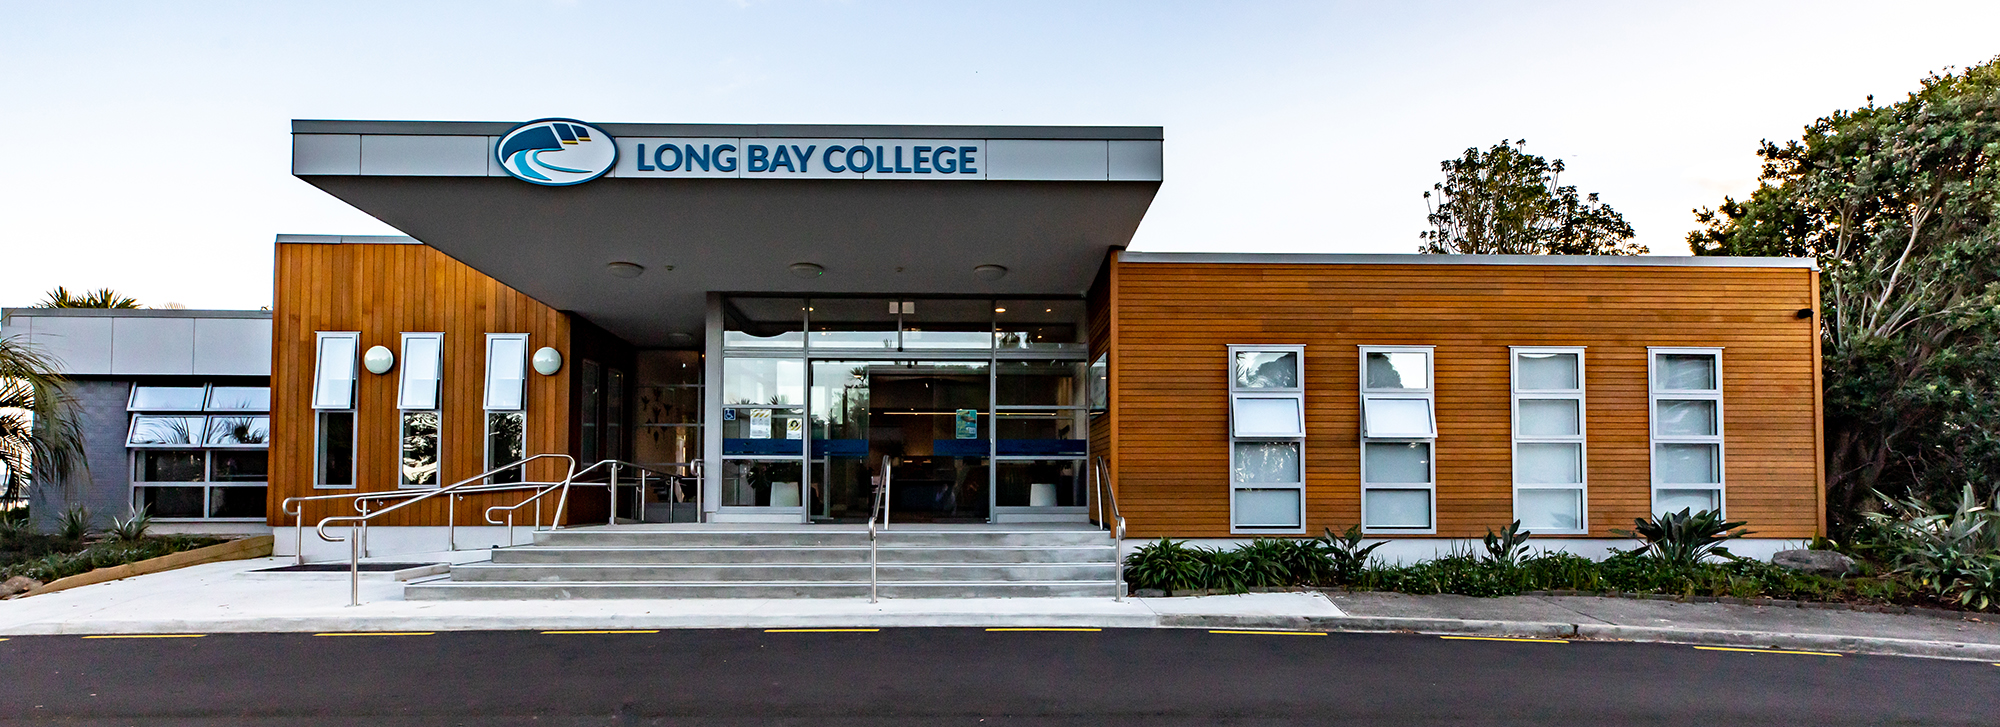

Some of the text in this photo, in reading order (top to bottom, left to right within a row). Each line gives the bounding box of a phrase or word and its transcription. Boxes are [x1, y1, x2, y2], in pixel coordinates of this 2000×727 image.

[637, 143, 978, 174] LONG BAY COLLEGE
